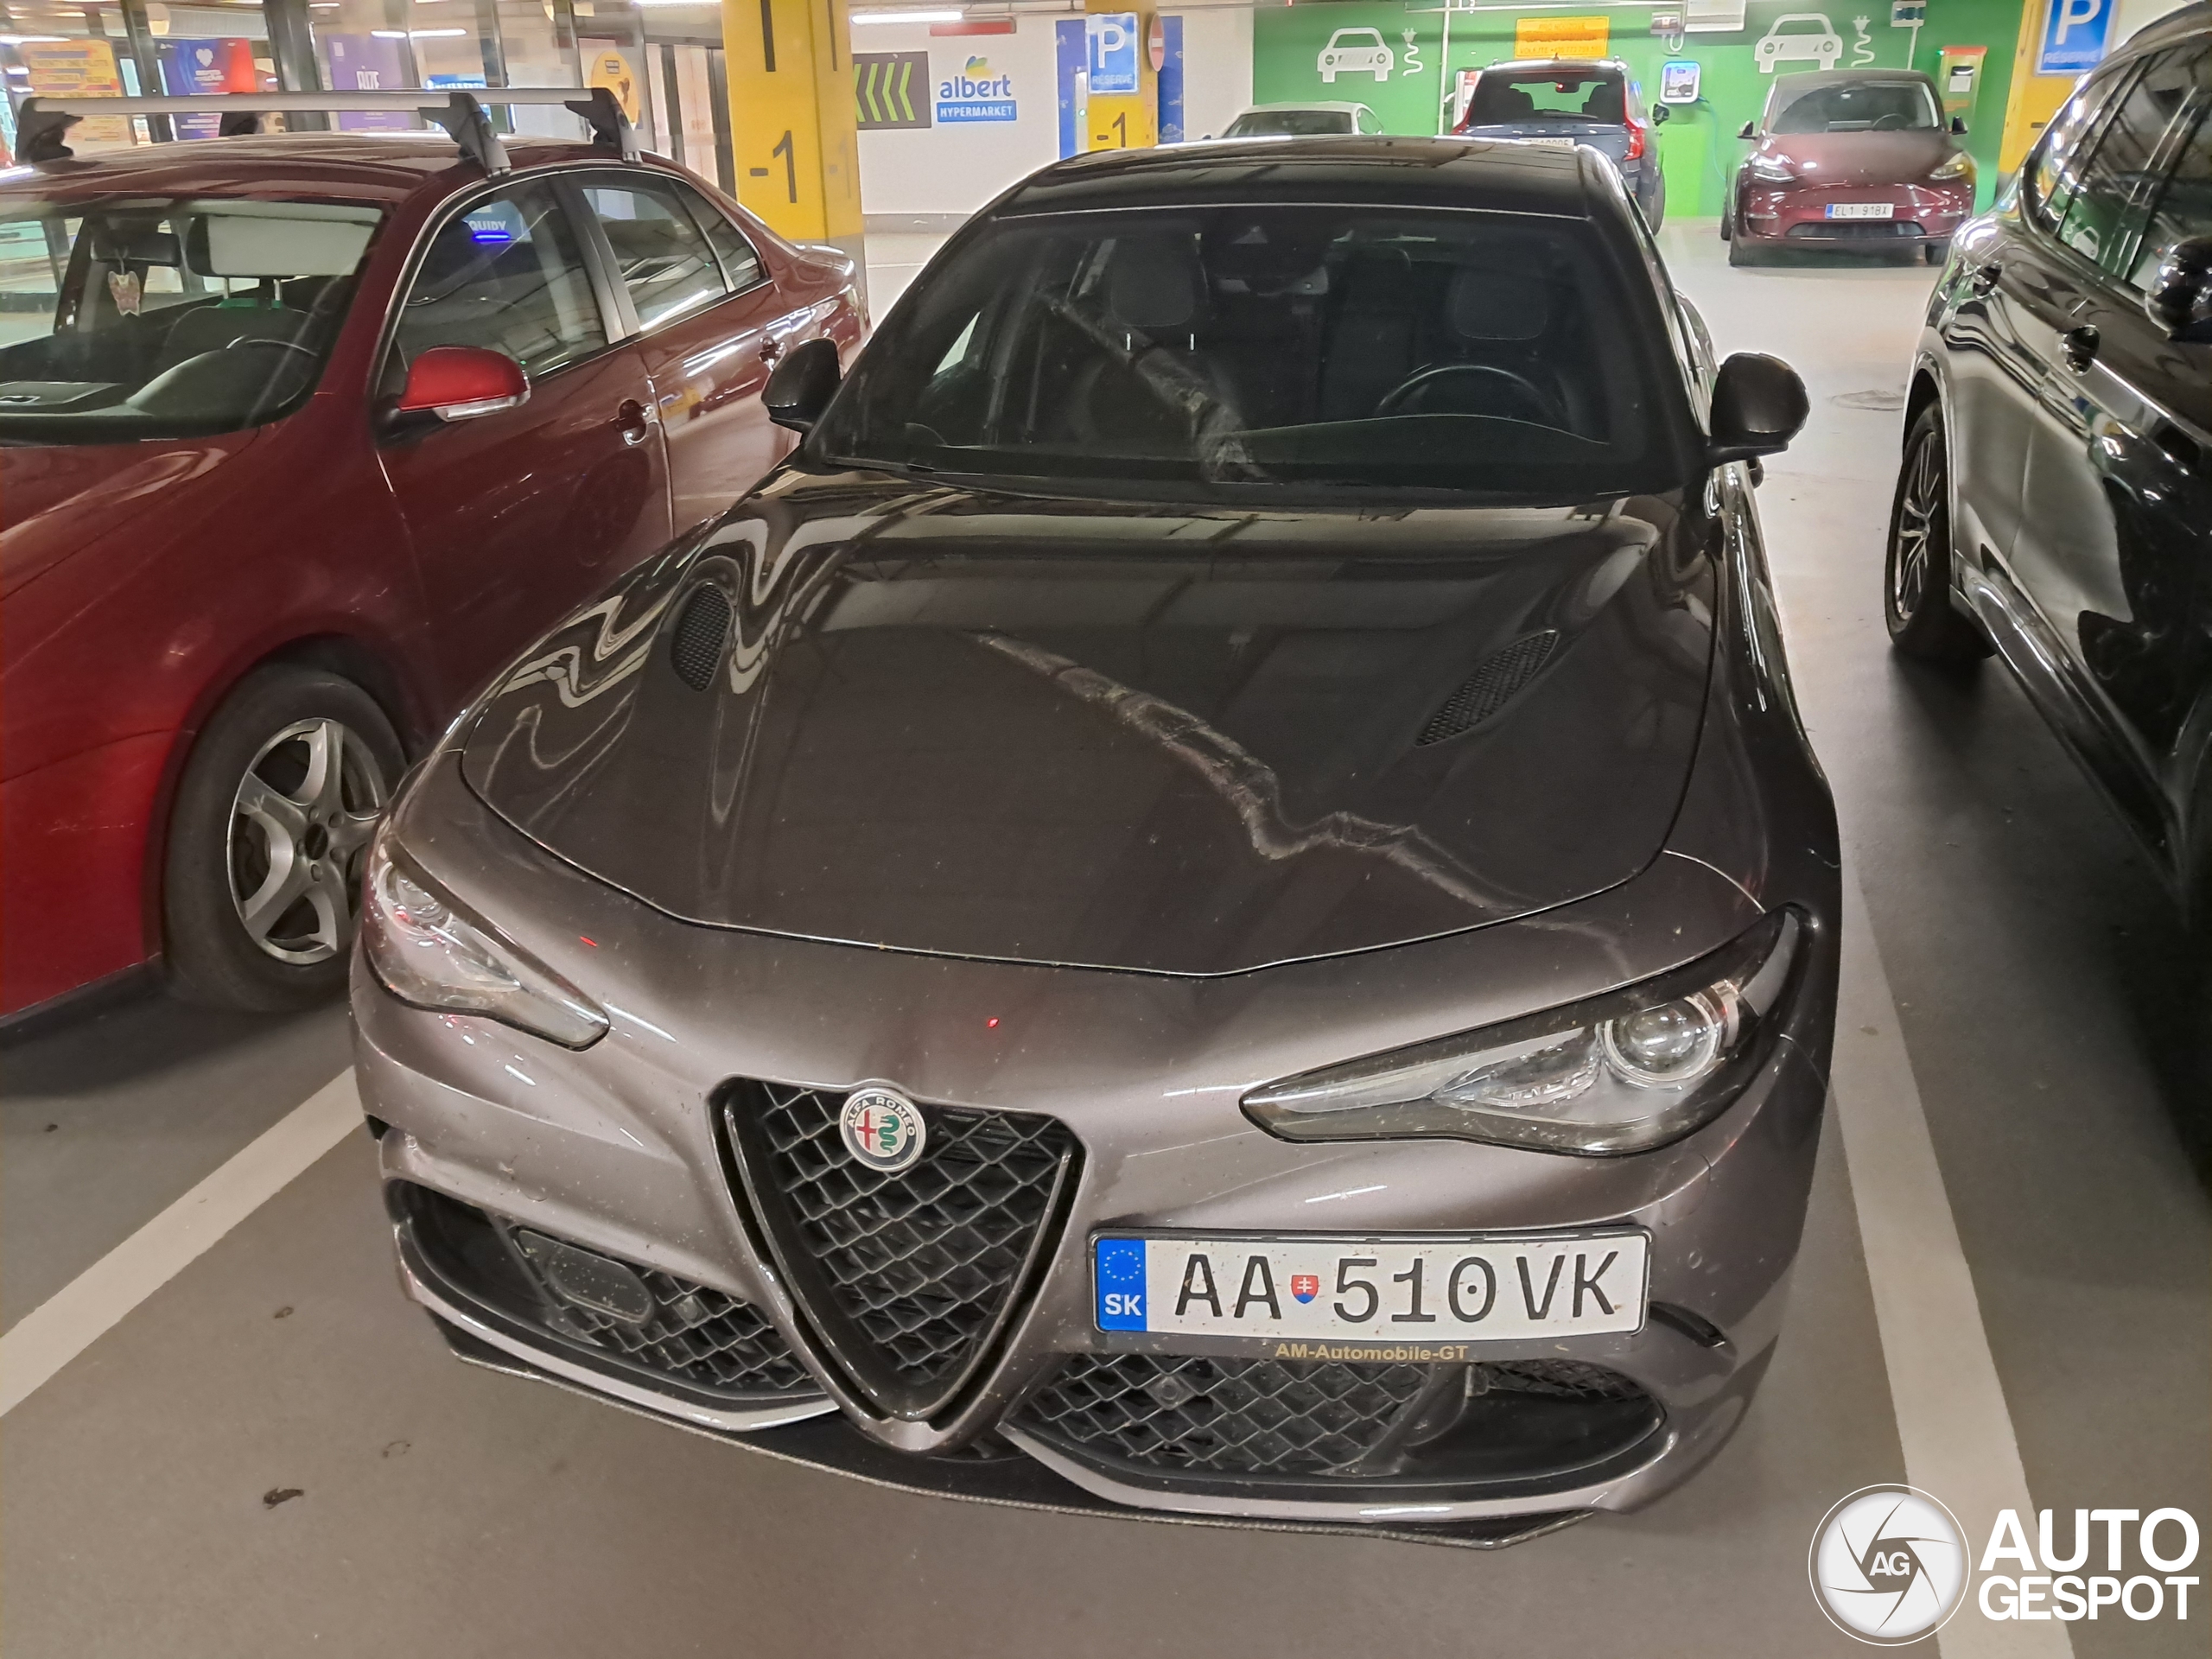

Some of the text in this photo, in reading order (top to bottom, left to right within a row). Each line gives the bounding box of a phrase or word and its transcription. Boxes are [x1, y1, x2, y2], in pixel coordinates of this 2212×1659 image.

[1096, 24, 1126, 68] P
[940, 74, 1012, 99] albert
[940, 105, 1013, 118] HYPERMARKET
[1096, 112, 1126, 148] -1
[749, 130, 797, 204] -1
[848, 1096, 915, 1136] ALFA ROMEO
[1103, 1293, 1141, 1317] SK
[1174, 1250, 1620, 1324] AA 510 VK
[1274, 1342, 1469, 1361] AM-Automobile-GT
